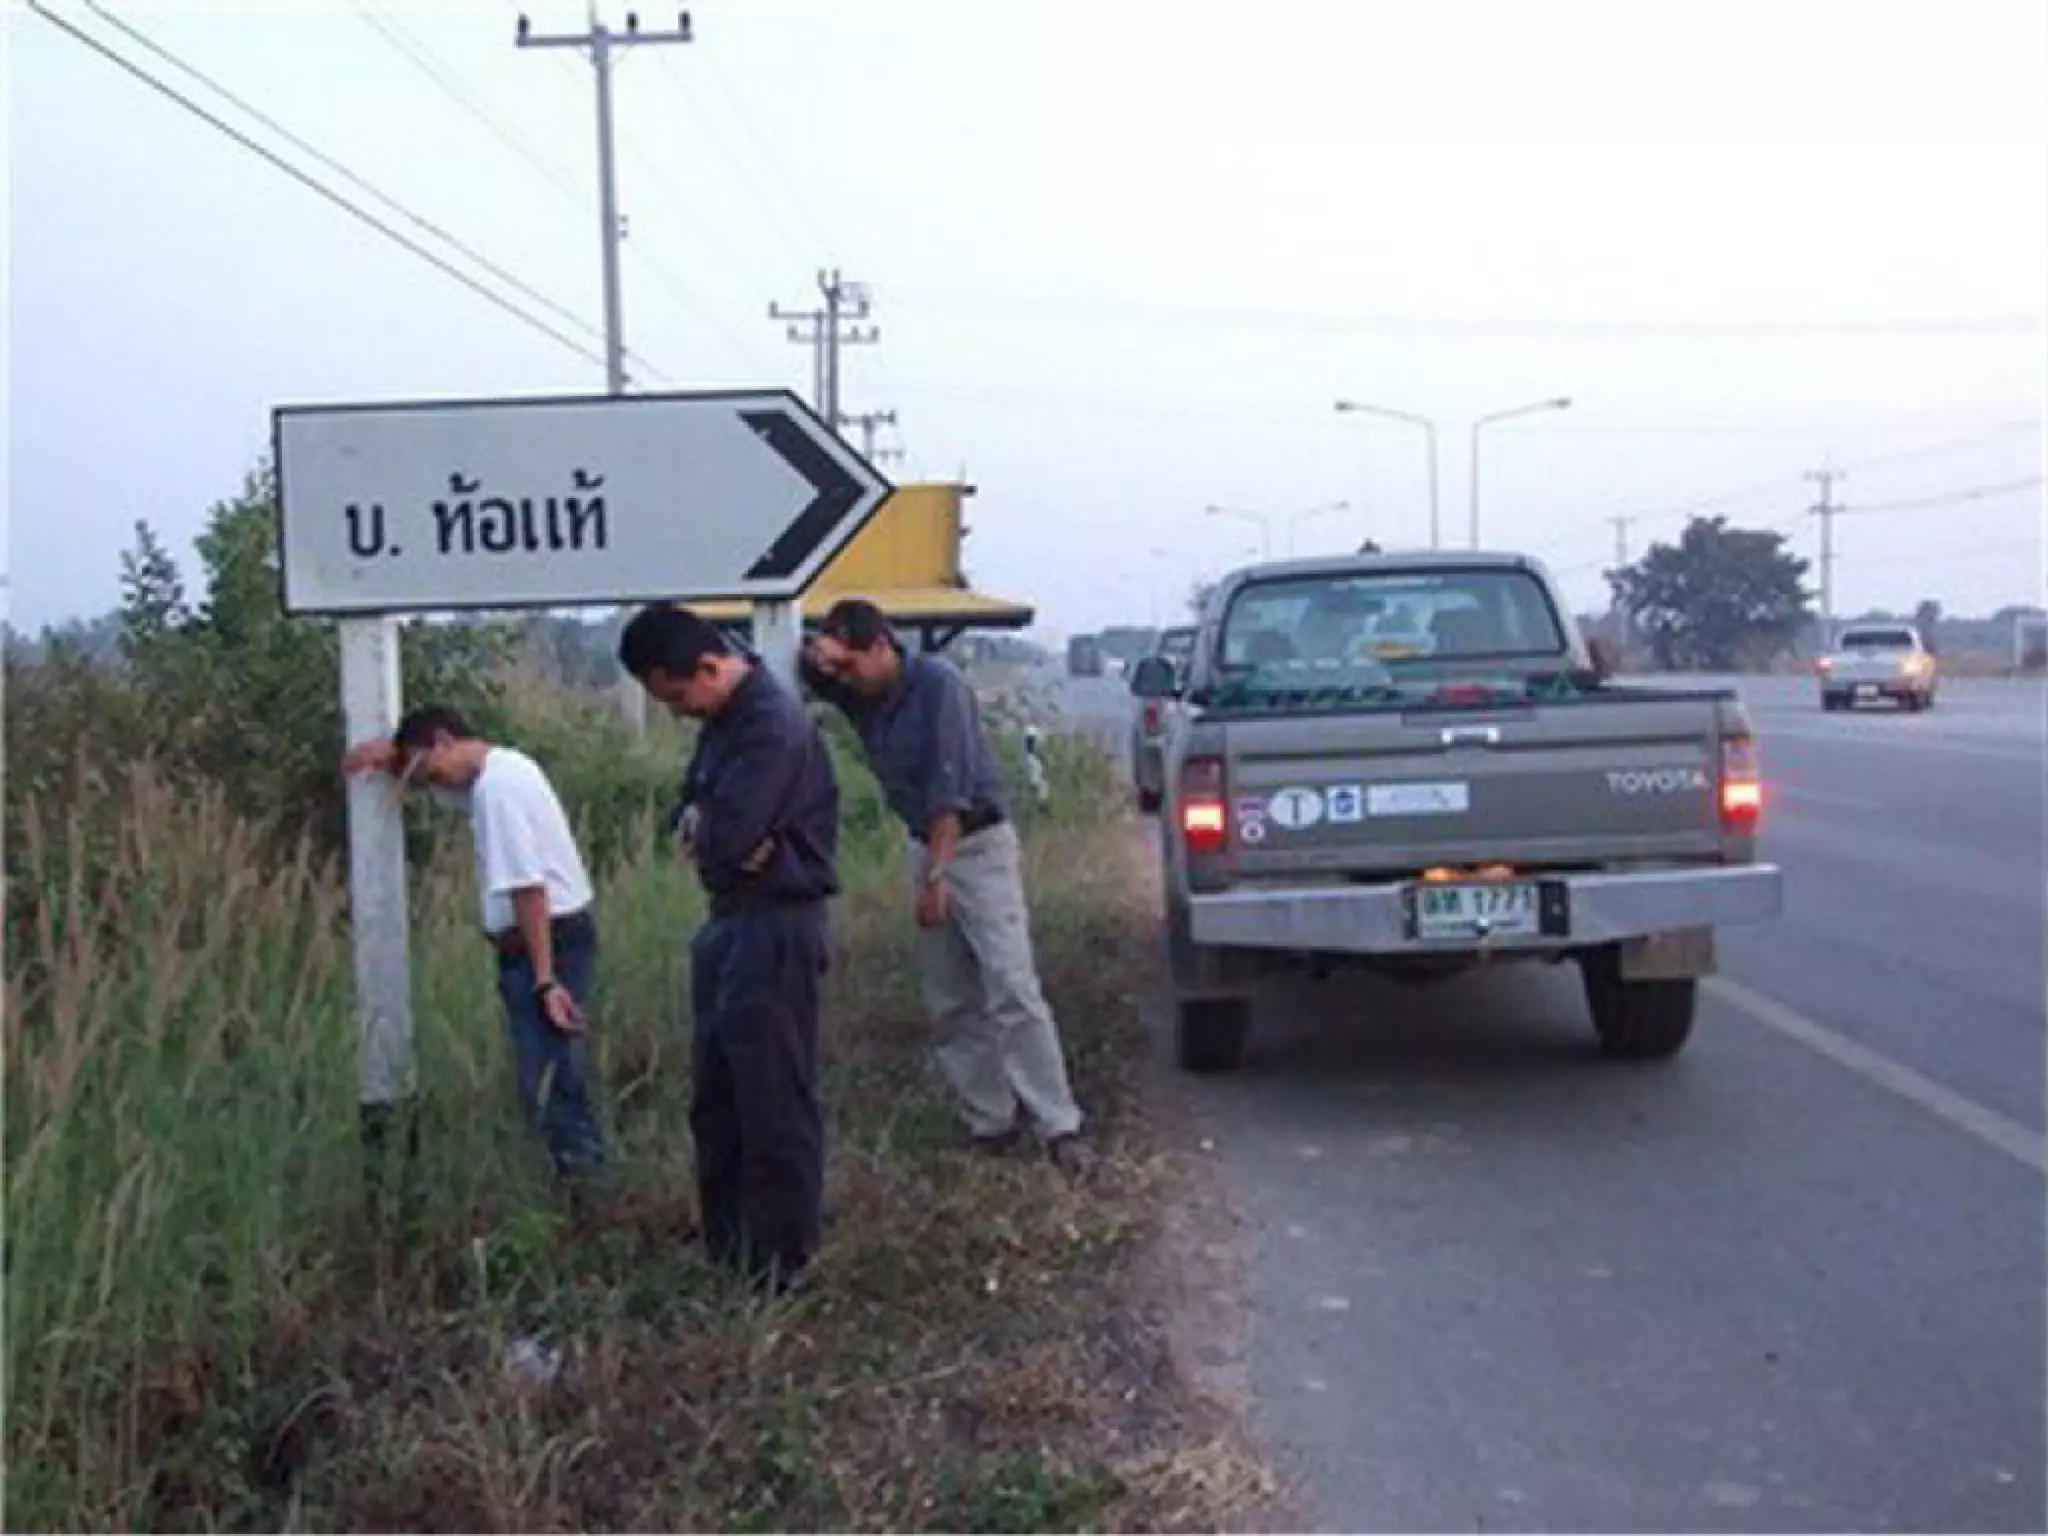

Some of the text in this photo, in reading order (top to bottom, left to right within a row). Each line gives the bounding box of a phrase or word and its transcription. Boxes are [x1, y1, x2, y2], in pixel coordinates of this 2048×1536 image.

[345, 468, 608, 558] บ. ท้อแท้
[1605, 769, 1710, 794] TOYOTA
